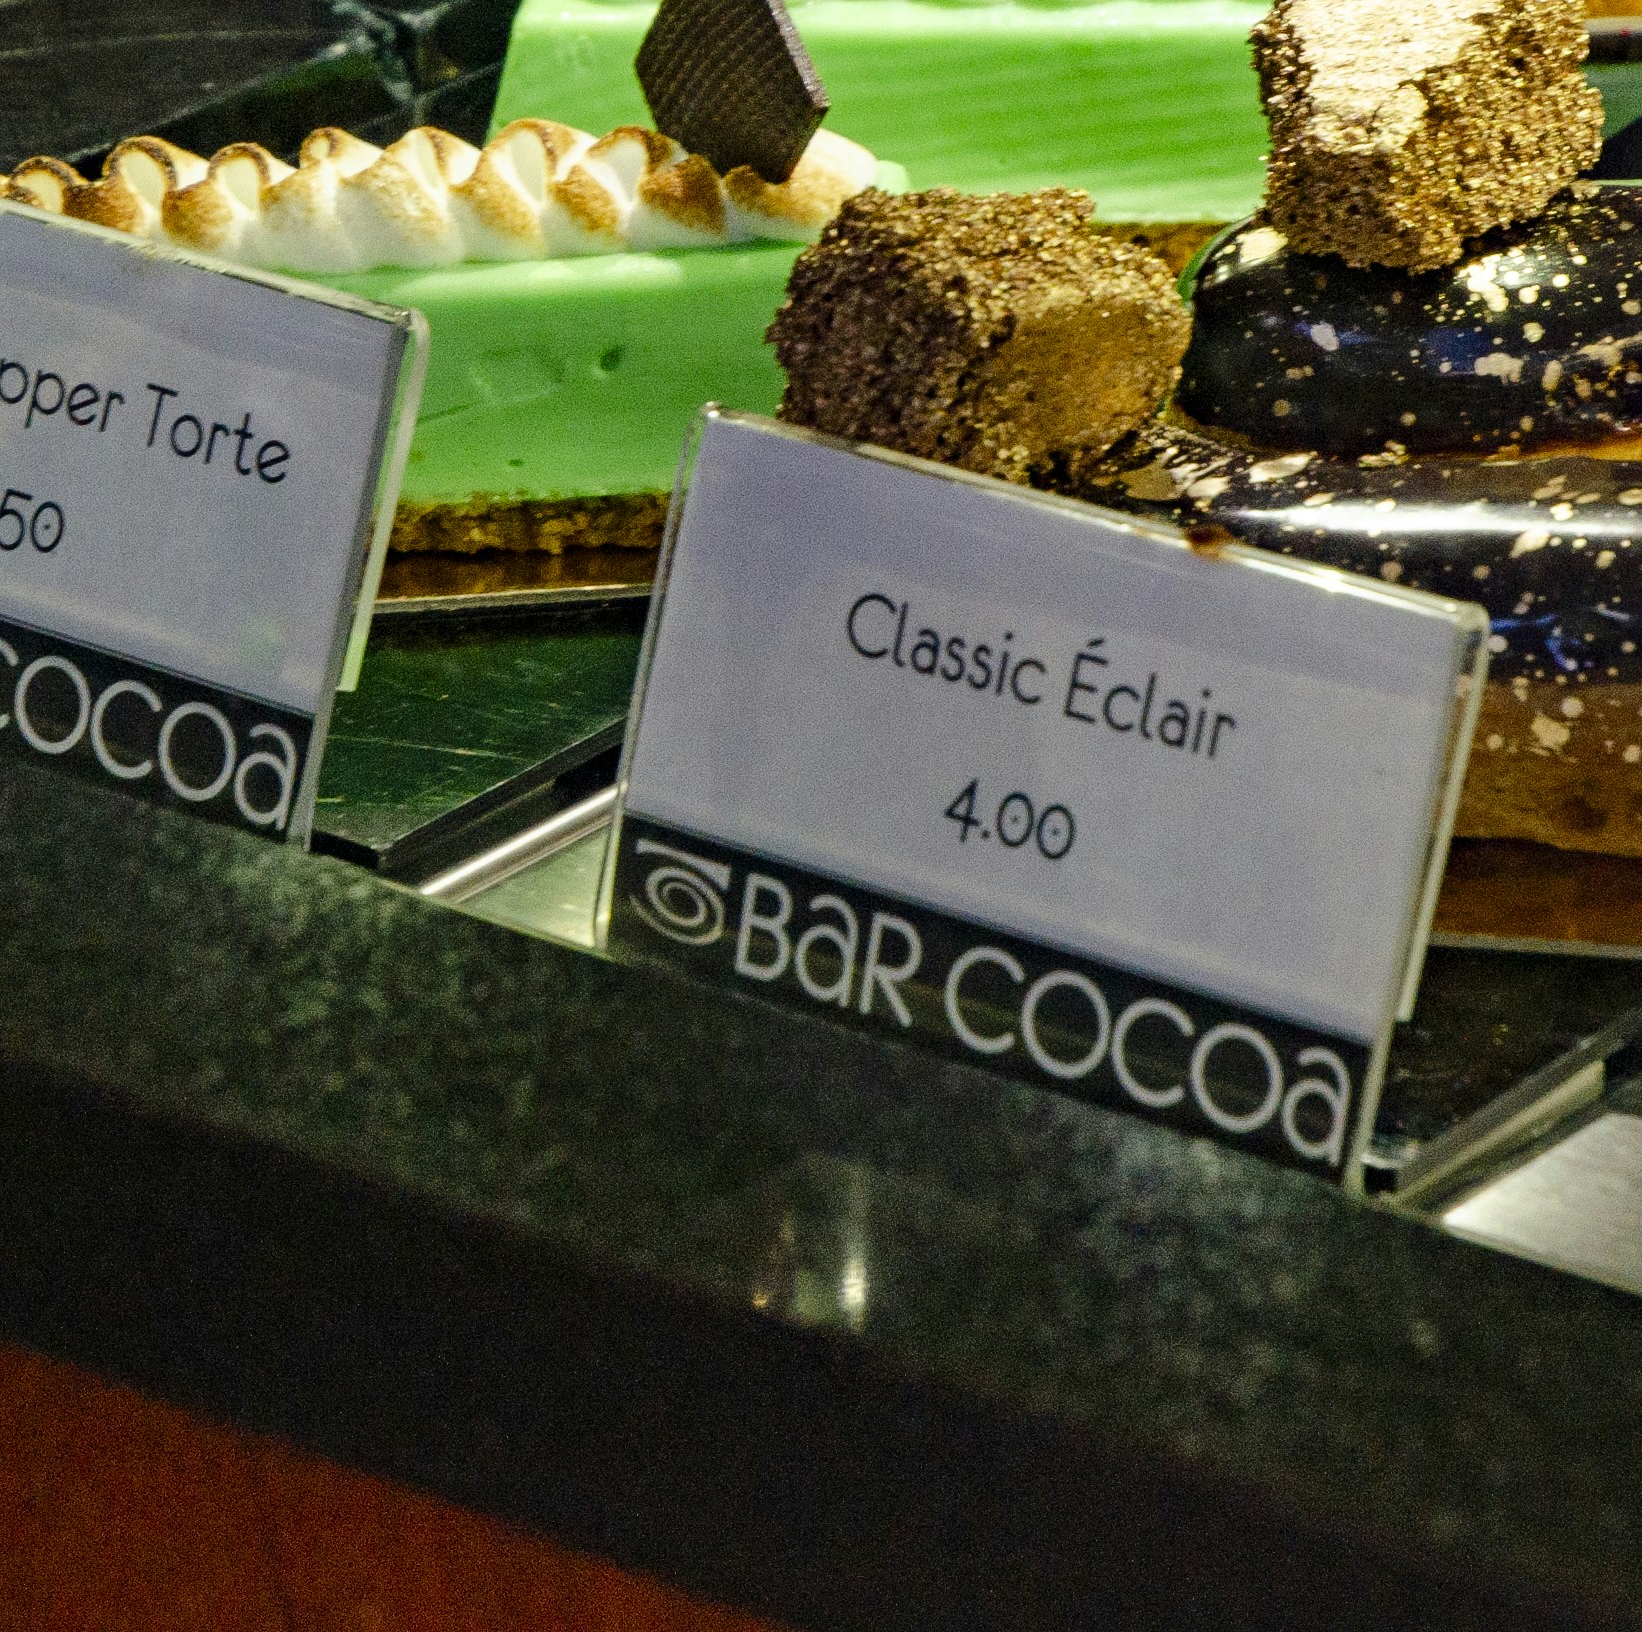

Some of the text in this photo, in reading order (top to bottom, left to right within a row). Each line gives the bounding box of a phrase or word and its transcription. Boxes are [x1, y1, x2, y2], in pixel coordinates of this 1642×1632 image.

[147, 381, 291, 485] Torte
[845, 591, 1237, 761] Classic Éclair
[945, 778, 1076, 861] 4.00
